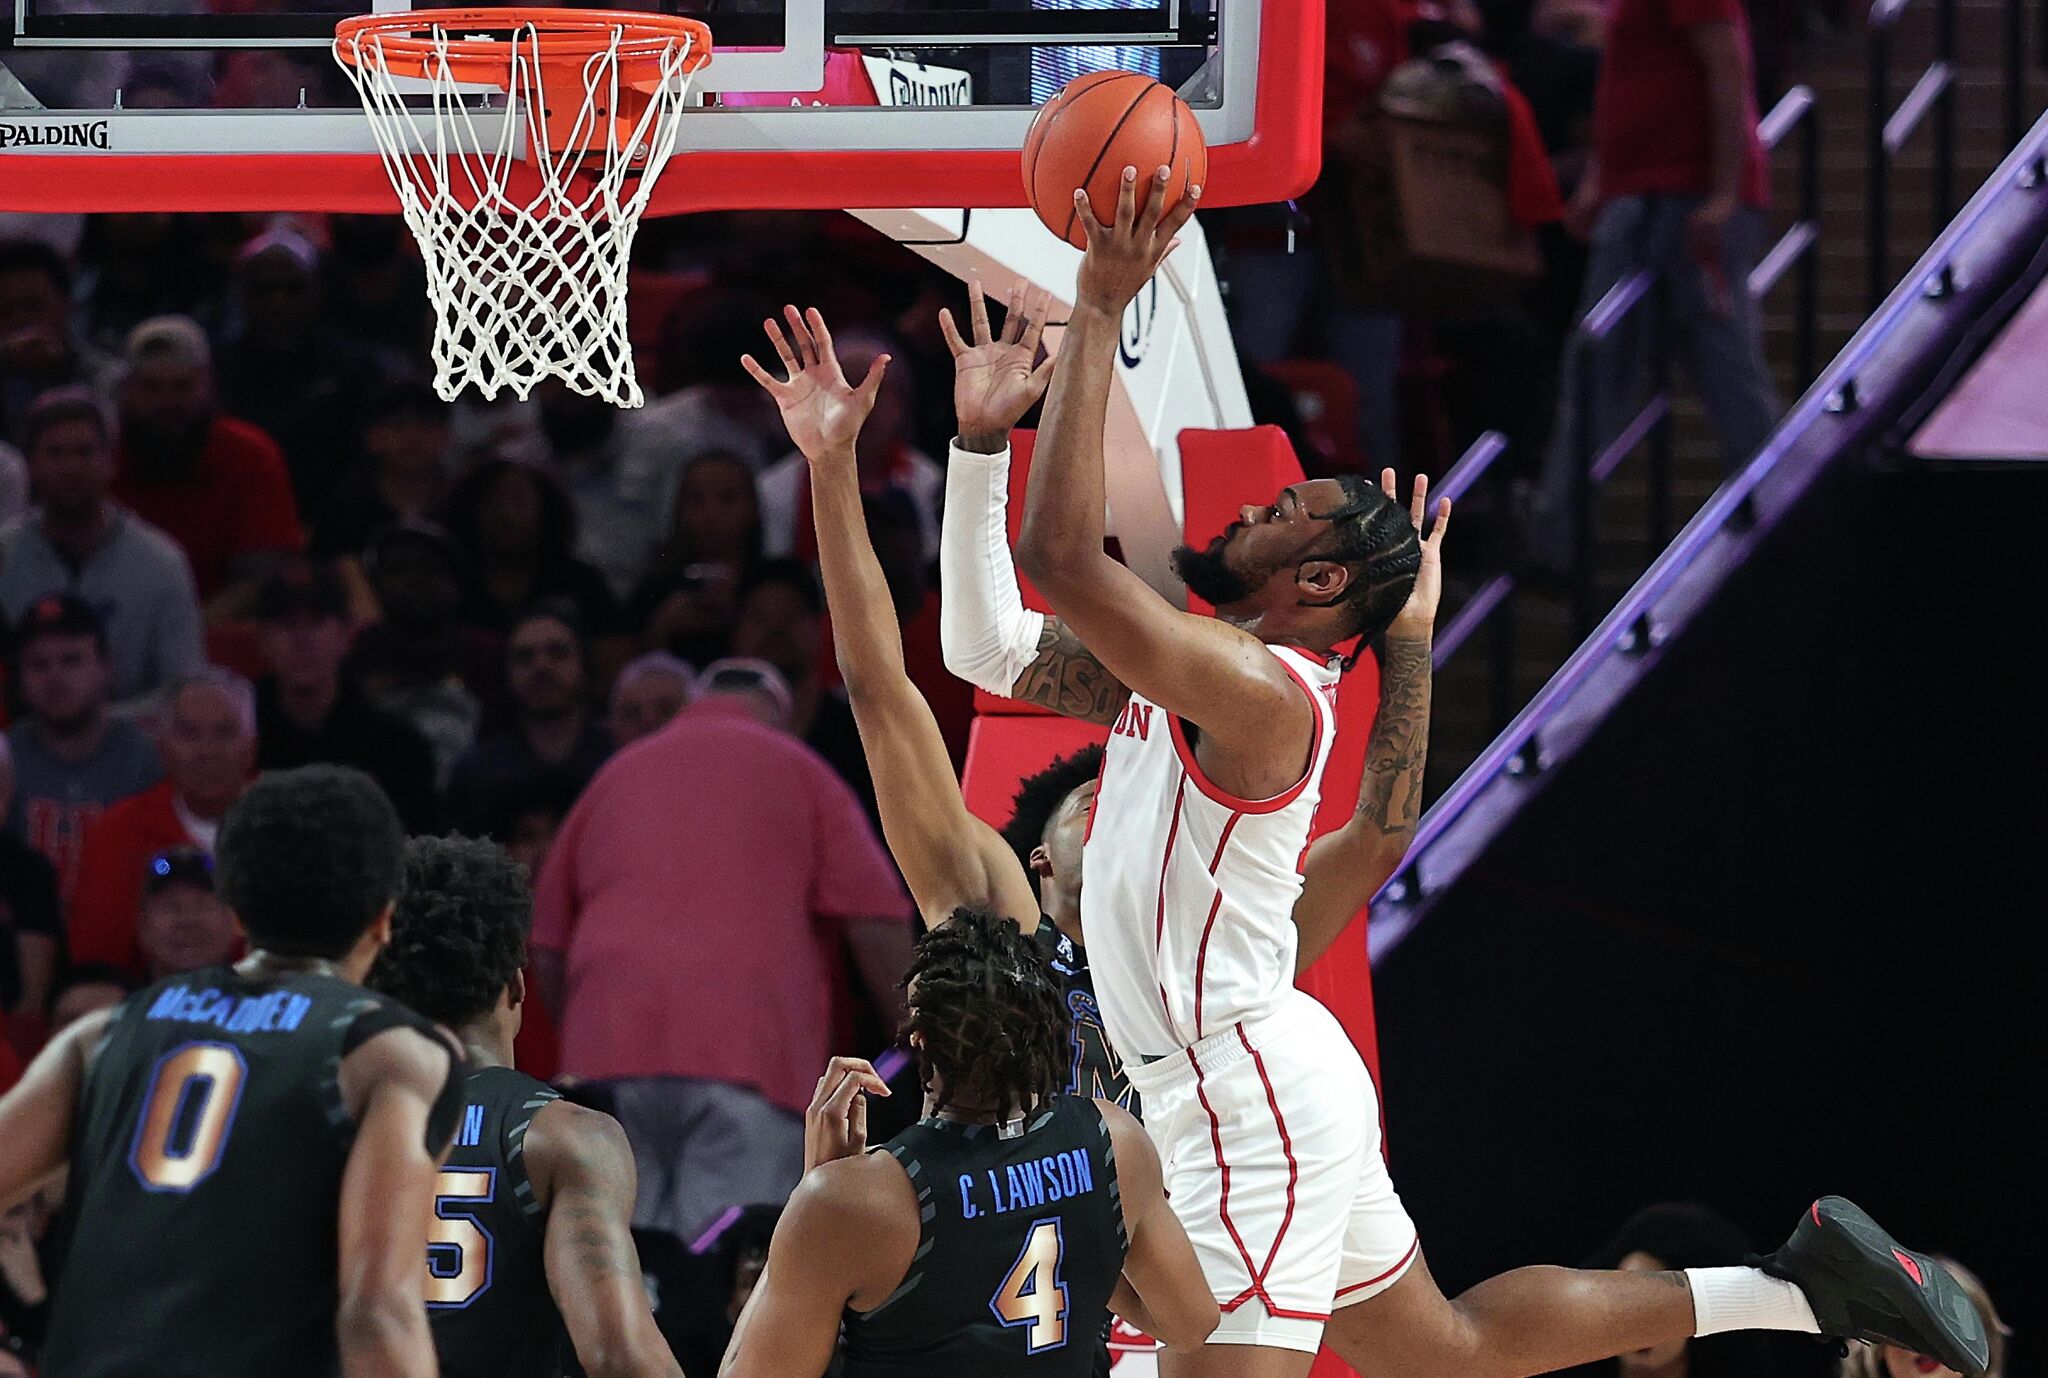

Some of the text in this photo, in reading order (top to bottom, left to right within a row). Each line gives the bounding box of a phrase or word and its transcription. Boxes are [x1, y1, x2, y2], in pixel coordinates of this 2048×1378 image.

[0, 121, 108, 149] PALDING
[128, 1040, 248, 1193] 0
[959, 1147, 1093, 1219] C. LAWSON
[989, 1216, 1069, 1355] 4
